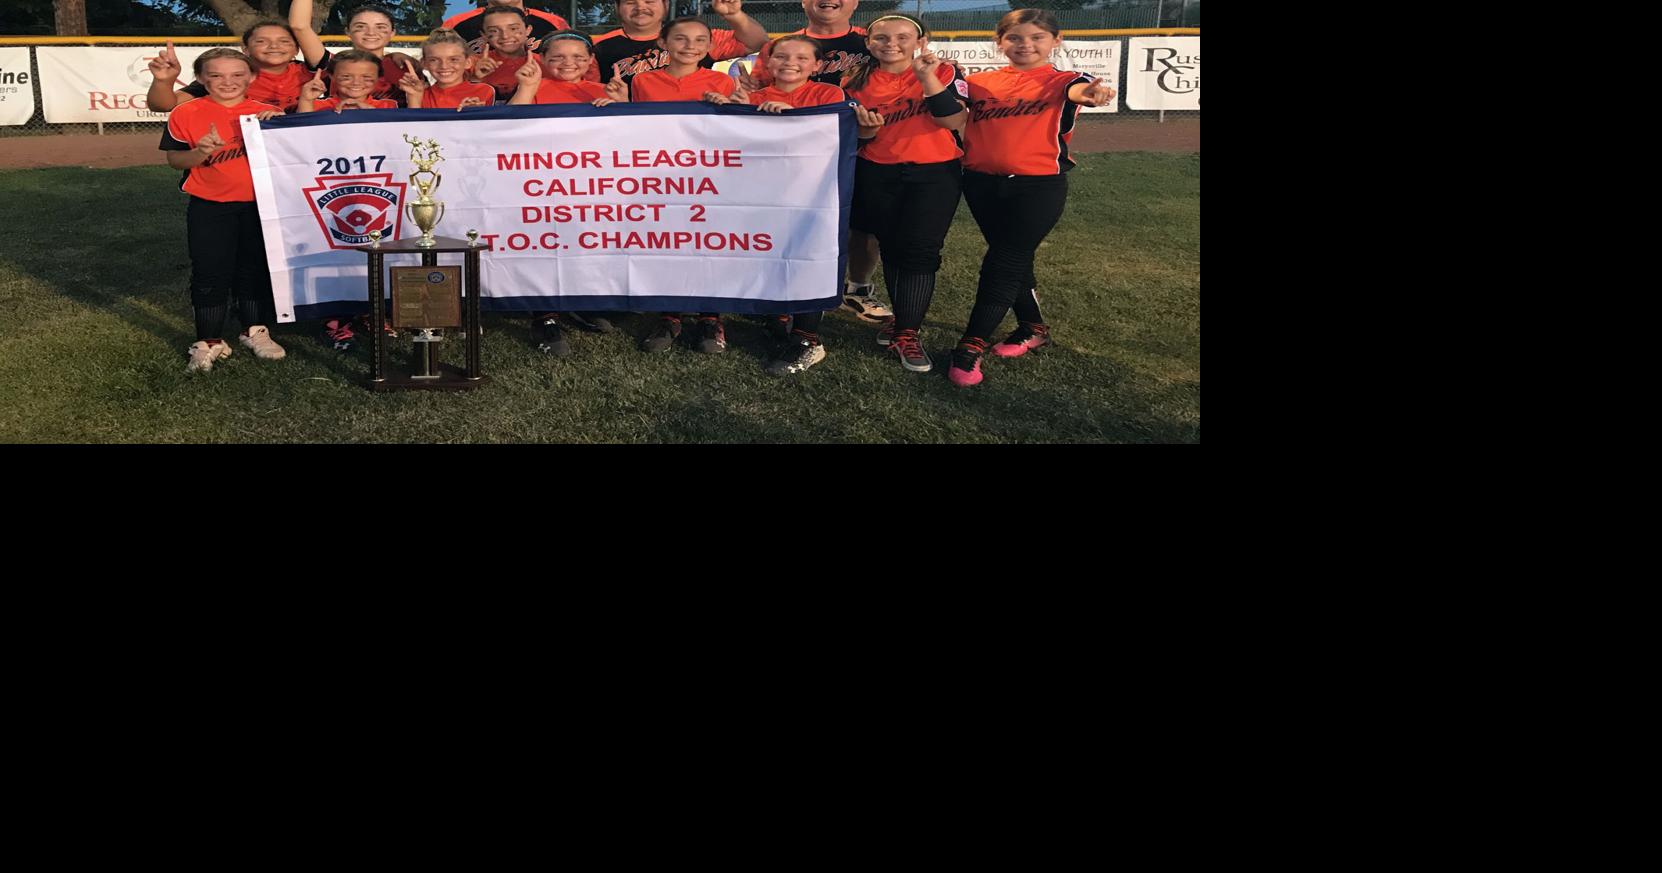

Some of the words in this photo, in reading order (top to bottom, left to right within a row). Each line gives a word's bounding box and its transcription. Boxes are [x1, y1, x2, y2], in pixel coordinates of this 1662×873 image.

[963, 49, 977, 60] TO
[1063, 48, 1103, 58] YOUTH
[88, 91, 149, 111] REG
[316, 155, 386, 175] 2017
[496, 151, 602, 172] MINOR
[612, 148, 742, 169] LEAGUE
[319, 189, 351, 204] LITTLE
[354, 186, 395, 200] LEAGUE
[522, 177, 719, 197] CALIFORNIA
[521, 203, 666, 223] DISTRICT
[689, 204, 706, 222] 2
[480, 232, 569, 252] T.O.C.
[578, 230, 773, 252] CHAMPIONS
